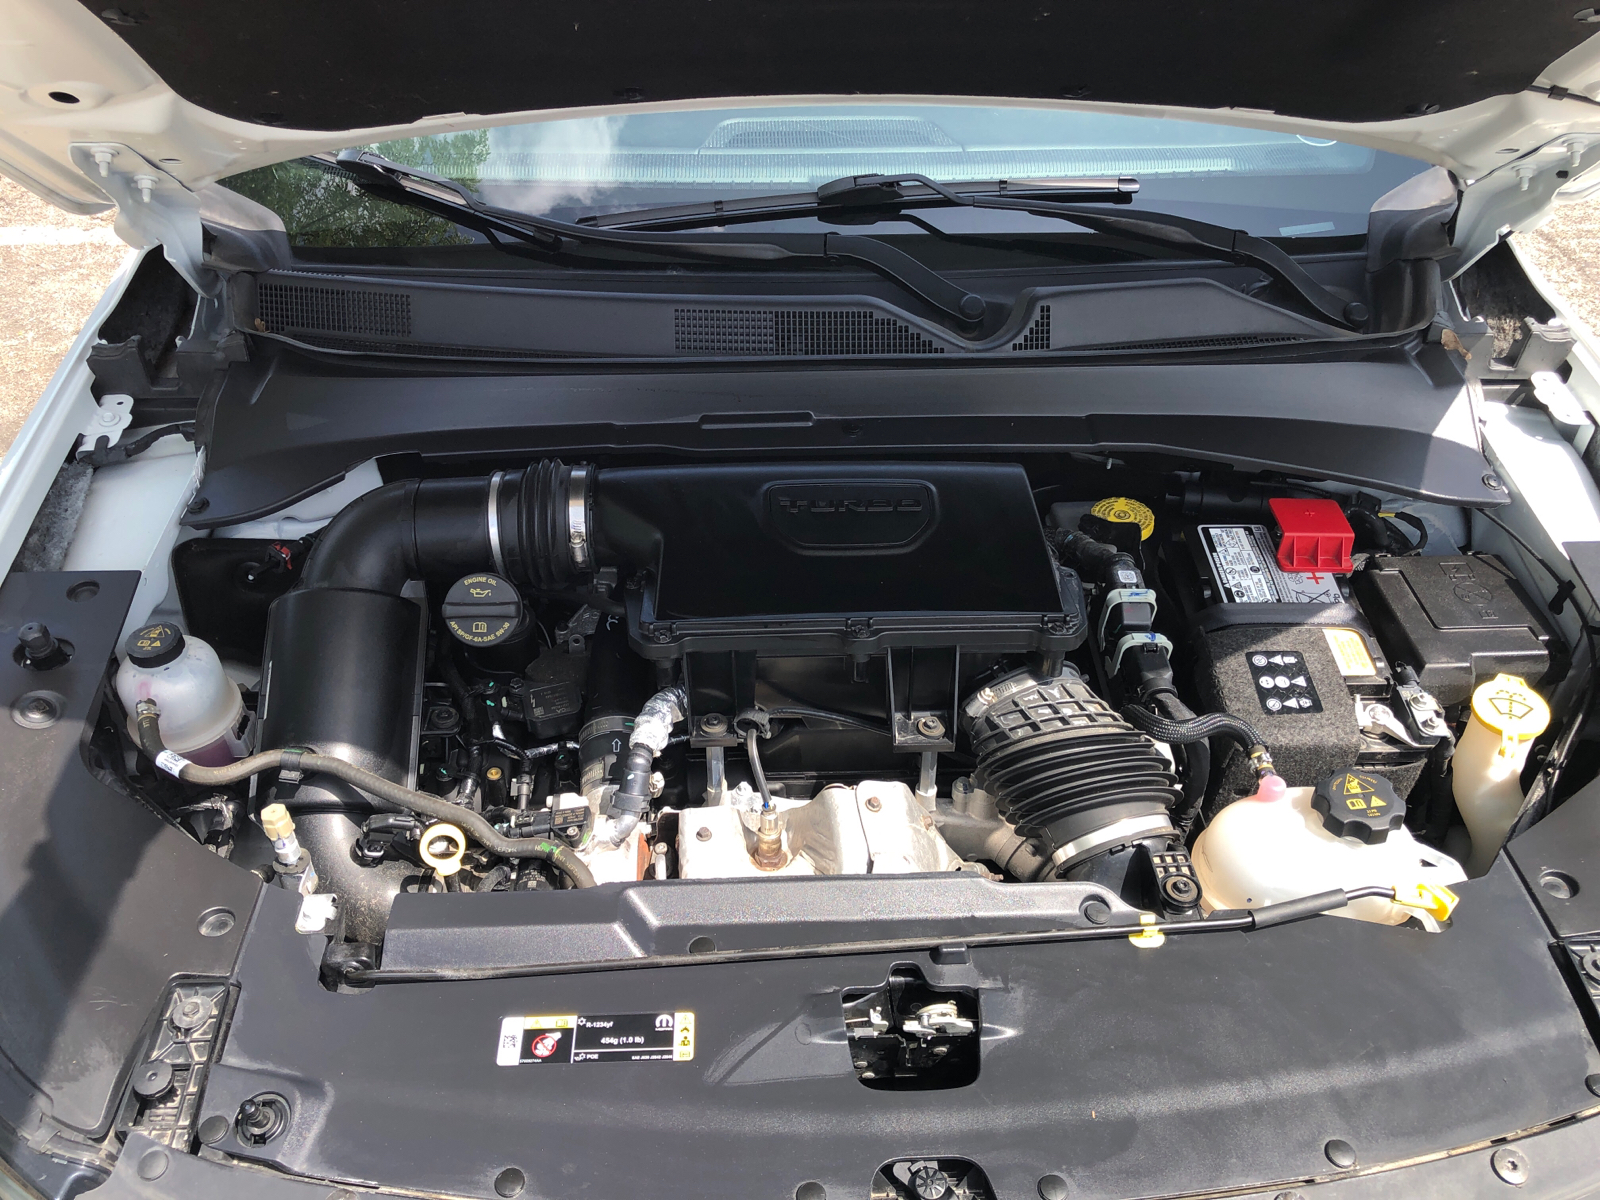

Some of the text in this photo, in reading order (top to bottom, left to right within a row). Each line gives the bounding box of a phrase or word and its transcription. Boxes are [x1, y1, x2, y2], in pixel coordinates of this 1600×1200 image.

[777, 496, 923, 514] TURBO
[464, 576, 497, 587] ENGINE OIL
[449, 621, 459, 631] API
[586, 1021, 614, 1029] R-1234yf
[600, 1036, 645, 1045] 454g (1.0 lb)
